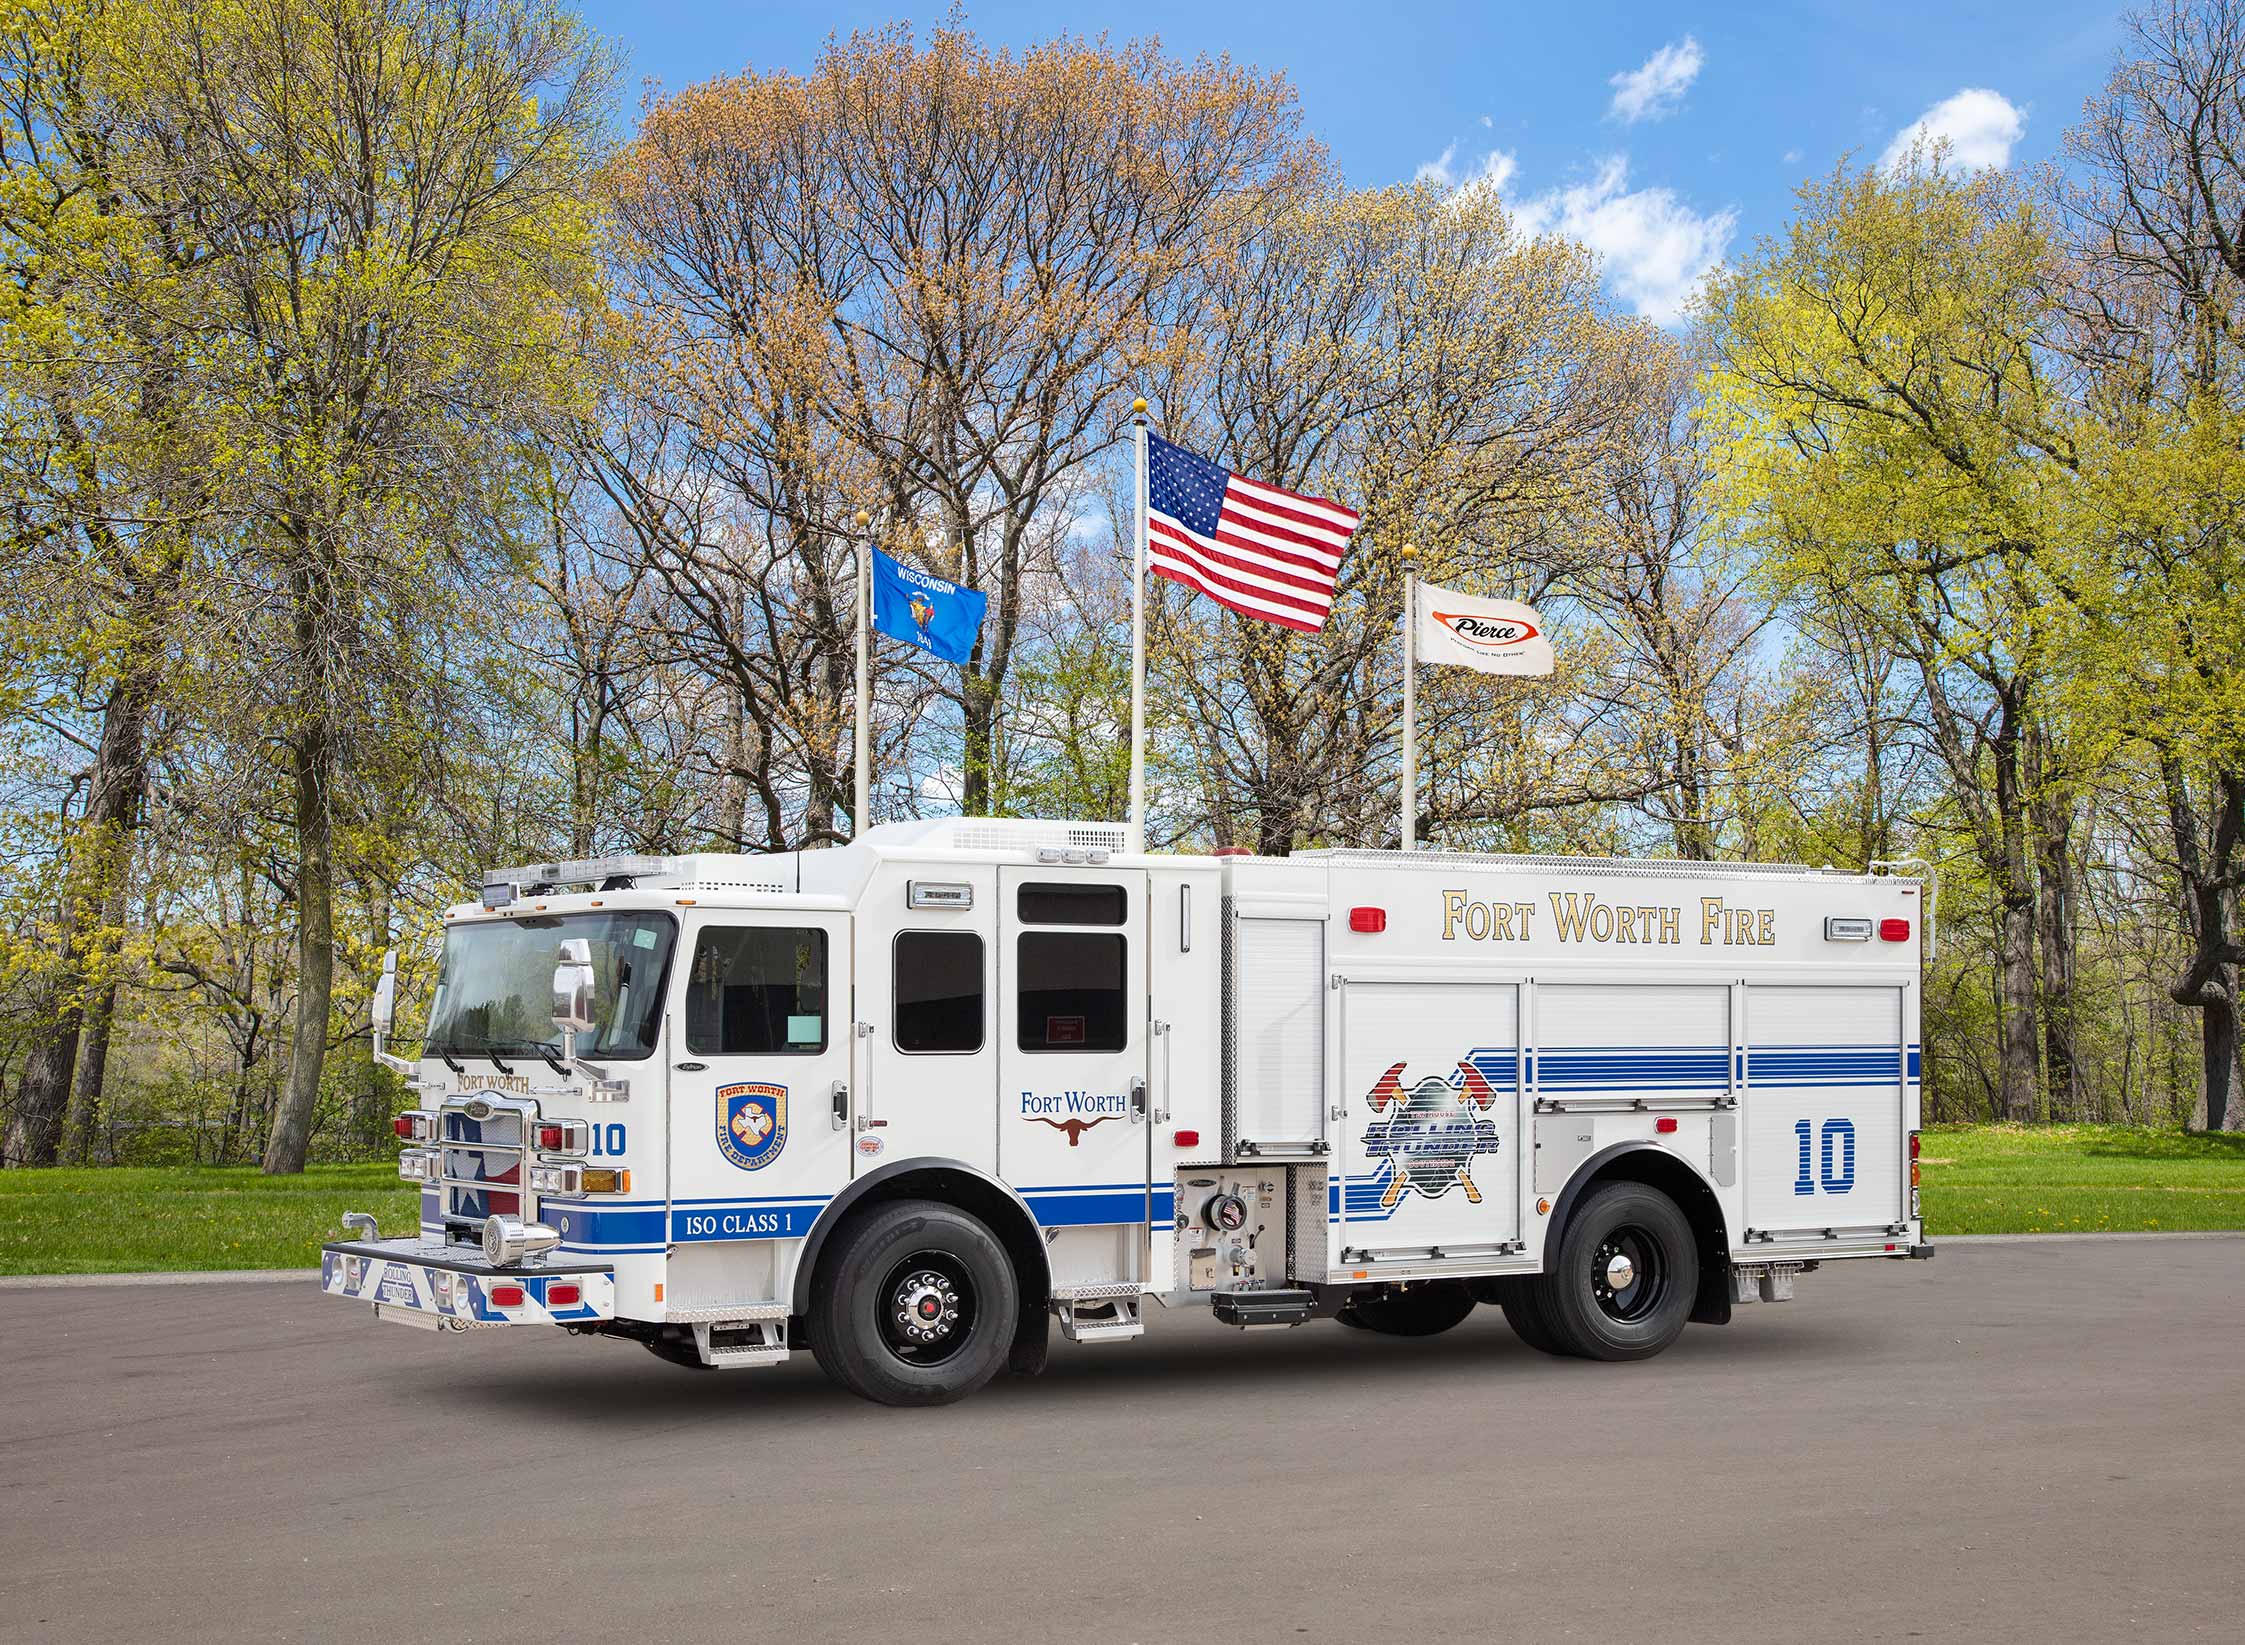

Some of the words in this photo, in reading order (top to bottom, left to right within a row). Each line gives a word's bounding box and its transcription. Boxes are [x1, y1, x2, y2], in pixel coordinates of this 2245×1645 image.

[897, 566, 956, 595] WISCONSIN
[1456, 618, 1516, 638] Pierce
[1442, 889, 1535, 941] FORT
[1548, 892, 1681, 944] WORTH
[1700, 896, 1775, 946] FIRE
[457, 1074, 484, 1093] FORT
[486, 1075, 529, 1095] WORTH
[720, 1086, 745, 1098] FORT
[748, 1085, 784, 1098] WORTH
[1021, 1091, 1062, 1113] FORT
[1064, 1091, 1126, 1113] WORTH
[592, 1123, 626, 1156] 10
[719, 1124, 733, 1153] FIRE
[730, 1124, 786, 1167] DEPARTMENT
[1794, 1118, 1855, 1195] 10
[686, 1215, 717, 1235] ISO
[722, 1213, 779, 1233] CLASS
[785, 1212, 792, 1231] 1
[384, 1266, 412, 1283] ROLLING
[382, 1284, 414, 1302] THUNDER
